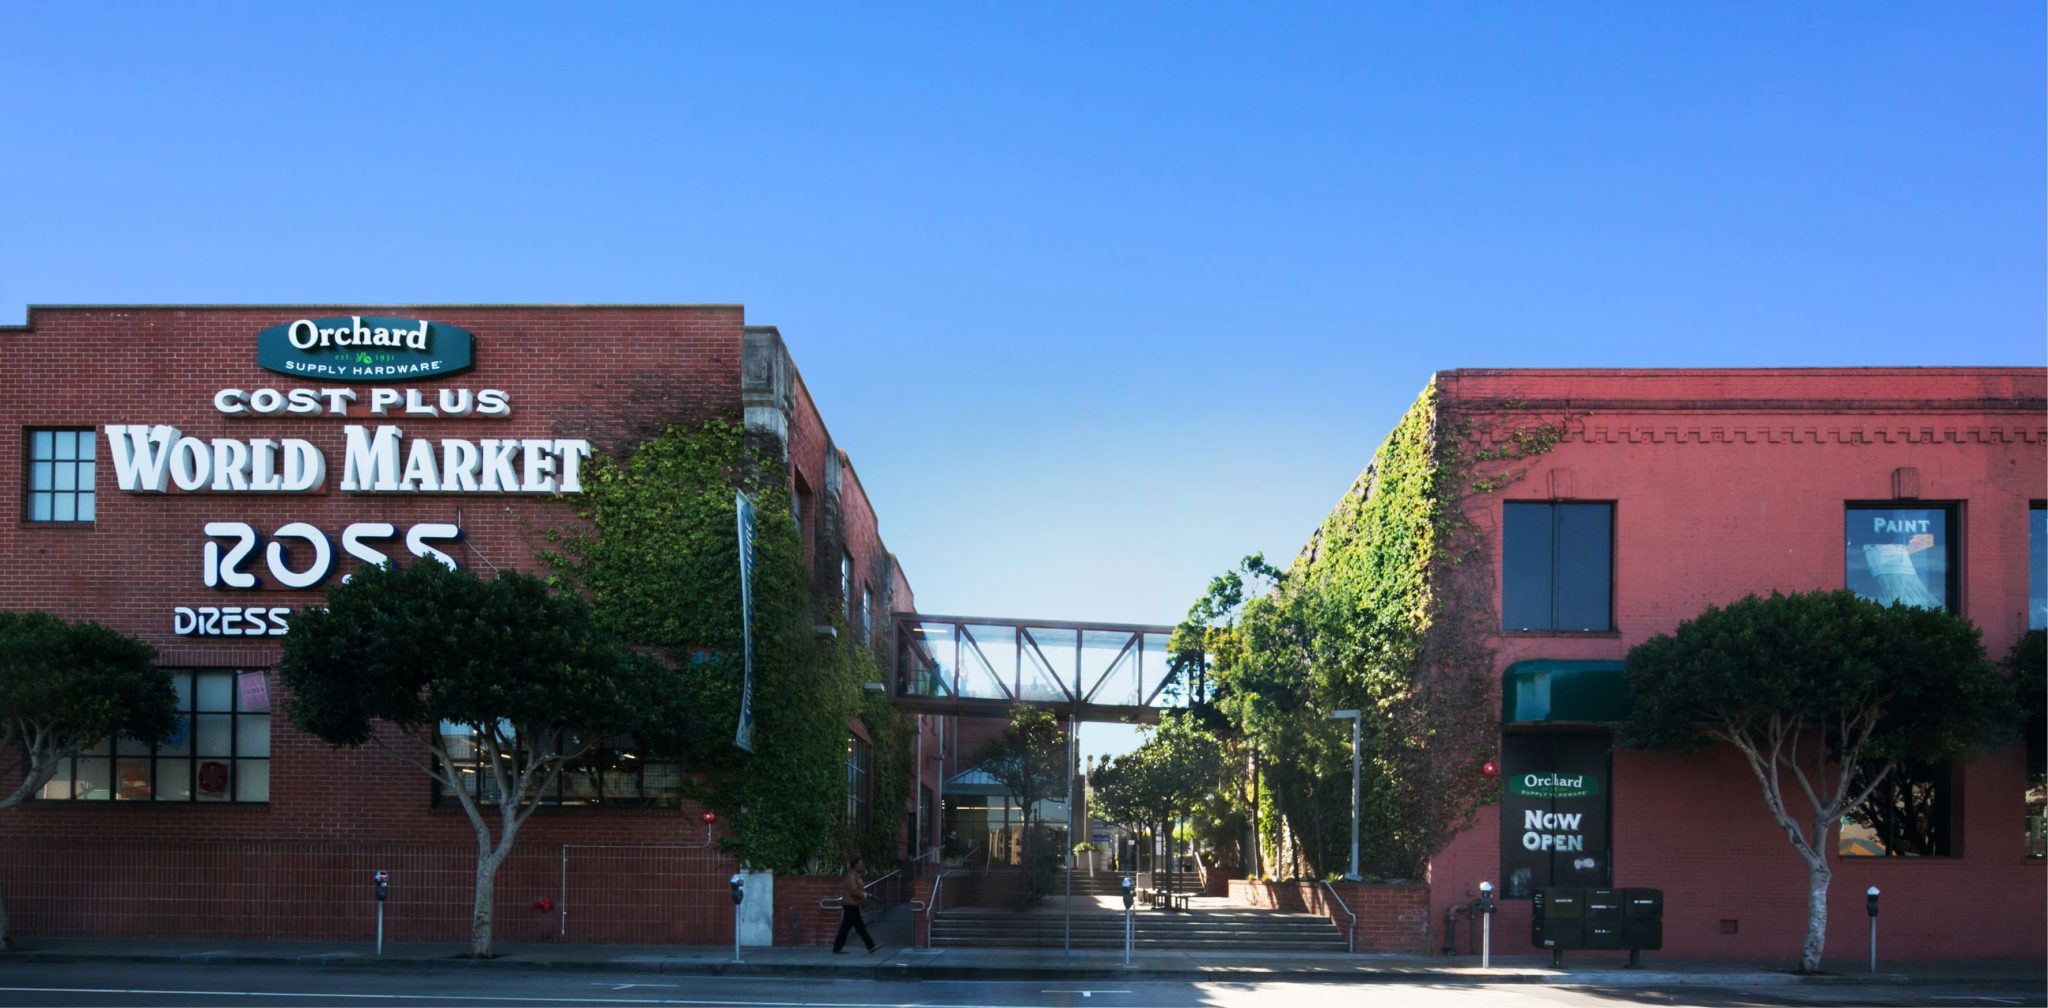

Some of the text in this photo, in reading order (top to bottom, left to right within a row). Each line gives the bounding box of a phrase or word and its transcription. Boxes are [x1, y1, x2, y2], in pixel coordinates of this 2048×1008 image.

[288, 316, 428, 350] Orchard
[286, 360, 440, 375] SUPPLY HARDWARE
[214, 388, 510, 417] COST PLUS
[105, 424, 591, 494] WORLD MARKET
[1873, 517, 1931, 533] PAINT
[204, 522, 459, 587] ROSS
[175, 607, 291, 635] DRESS
[1525, 772, 1583, 788] Orchard
[1524, 810, 1582, 830] NOW
[1522, 831, 1583, 851] OPEN
